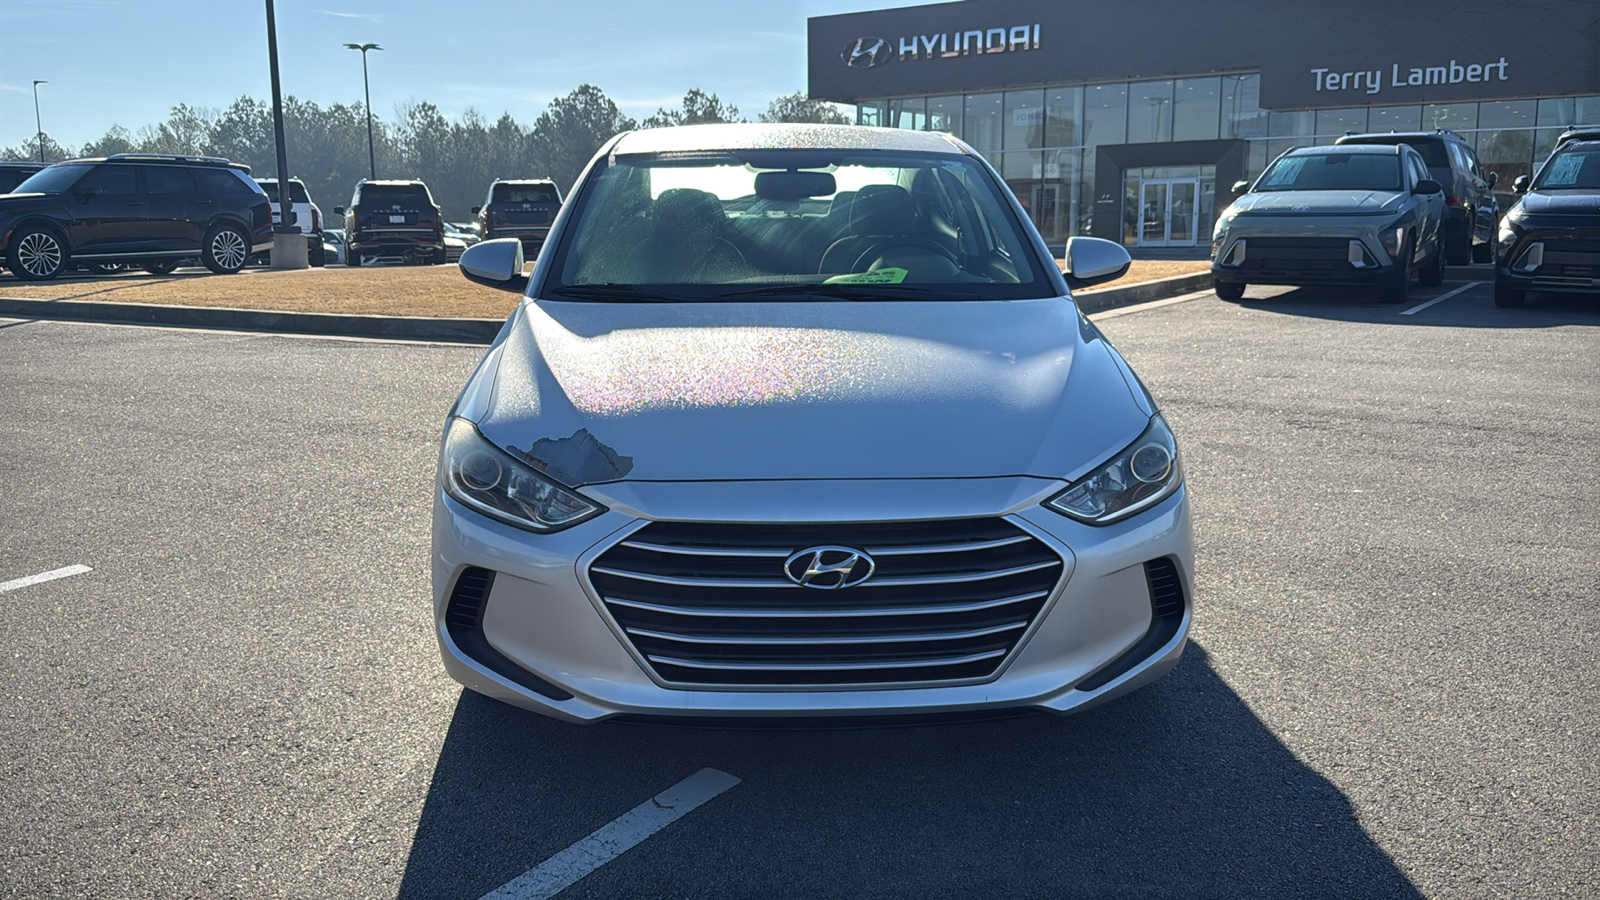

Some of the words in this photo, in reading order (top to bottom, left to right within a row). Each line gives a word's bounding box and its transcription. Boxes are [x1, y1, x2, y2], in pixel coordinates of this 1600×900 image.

[899, 24, 1040, 61] HYUNDAI
[1310, 68, 1381, 94] Terry
[1392, 57, 1509, 87] Lambert
